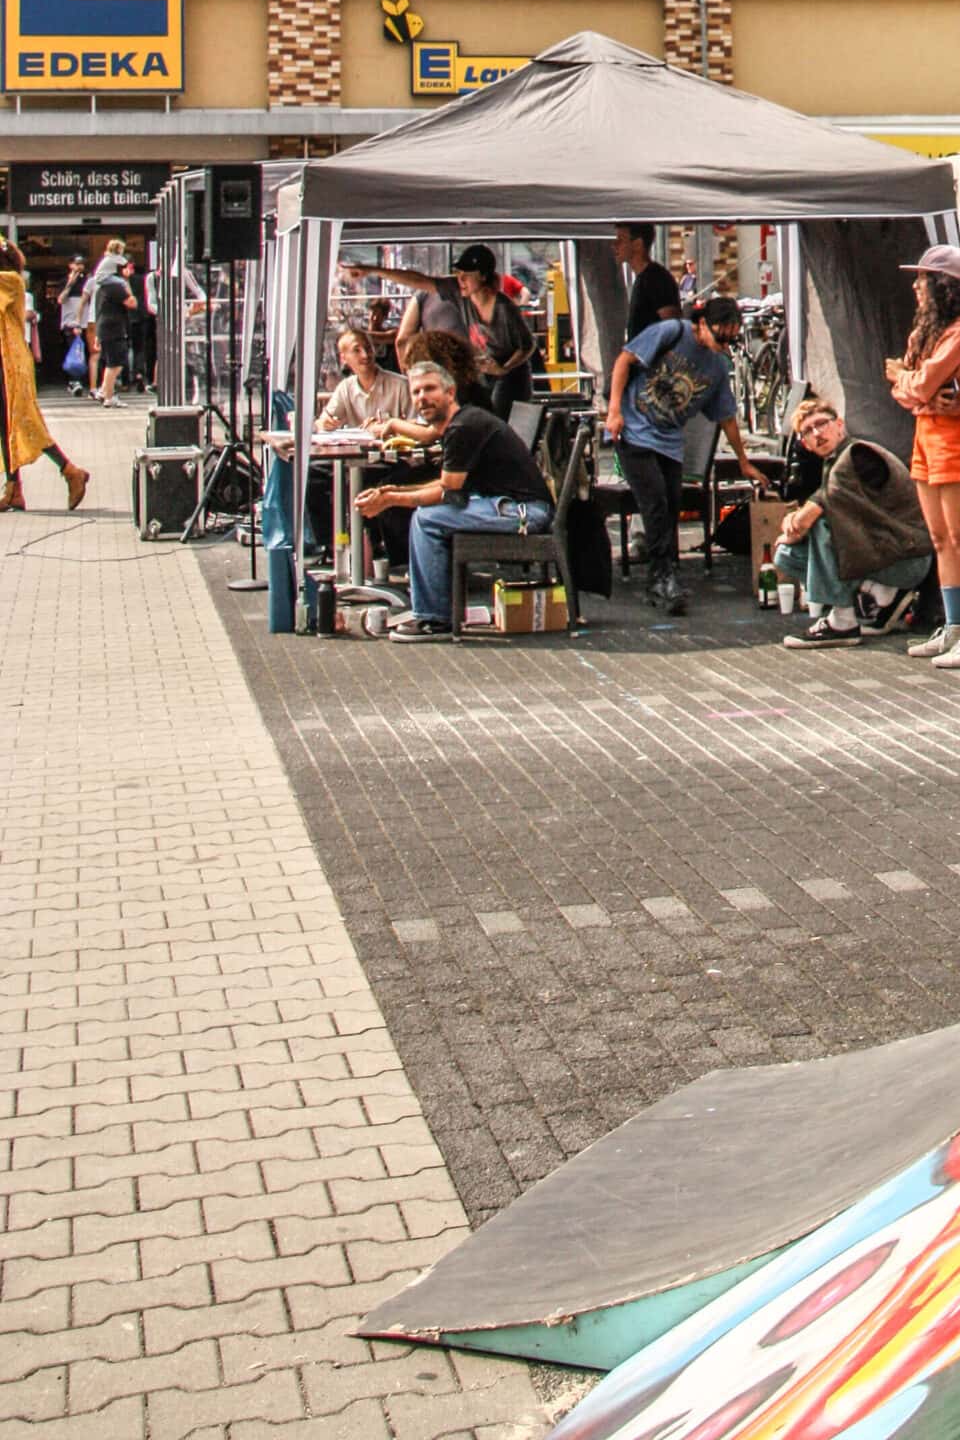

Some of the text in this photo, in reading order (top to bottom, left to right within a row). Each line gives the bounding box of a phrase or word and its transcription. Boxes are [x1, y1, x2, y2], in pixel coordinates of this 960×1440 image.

[18, 51, 169, 77] EDEKA
[420, 48, 450, 79] E
[41, 170, 142, 188] Schön, dass Sie
[29, 191, 75, 206] unsere
[78, 189, 110, 205] Liebe
